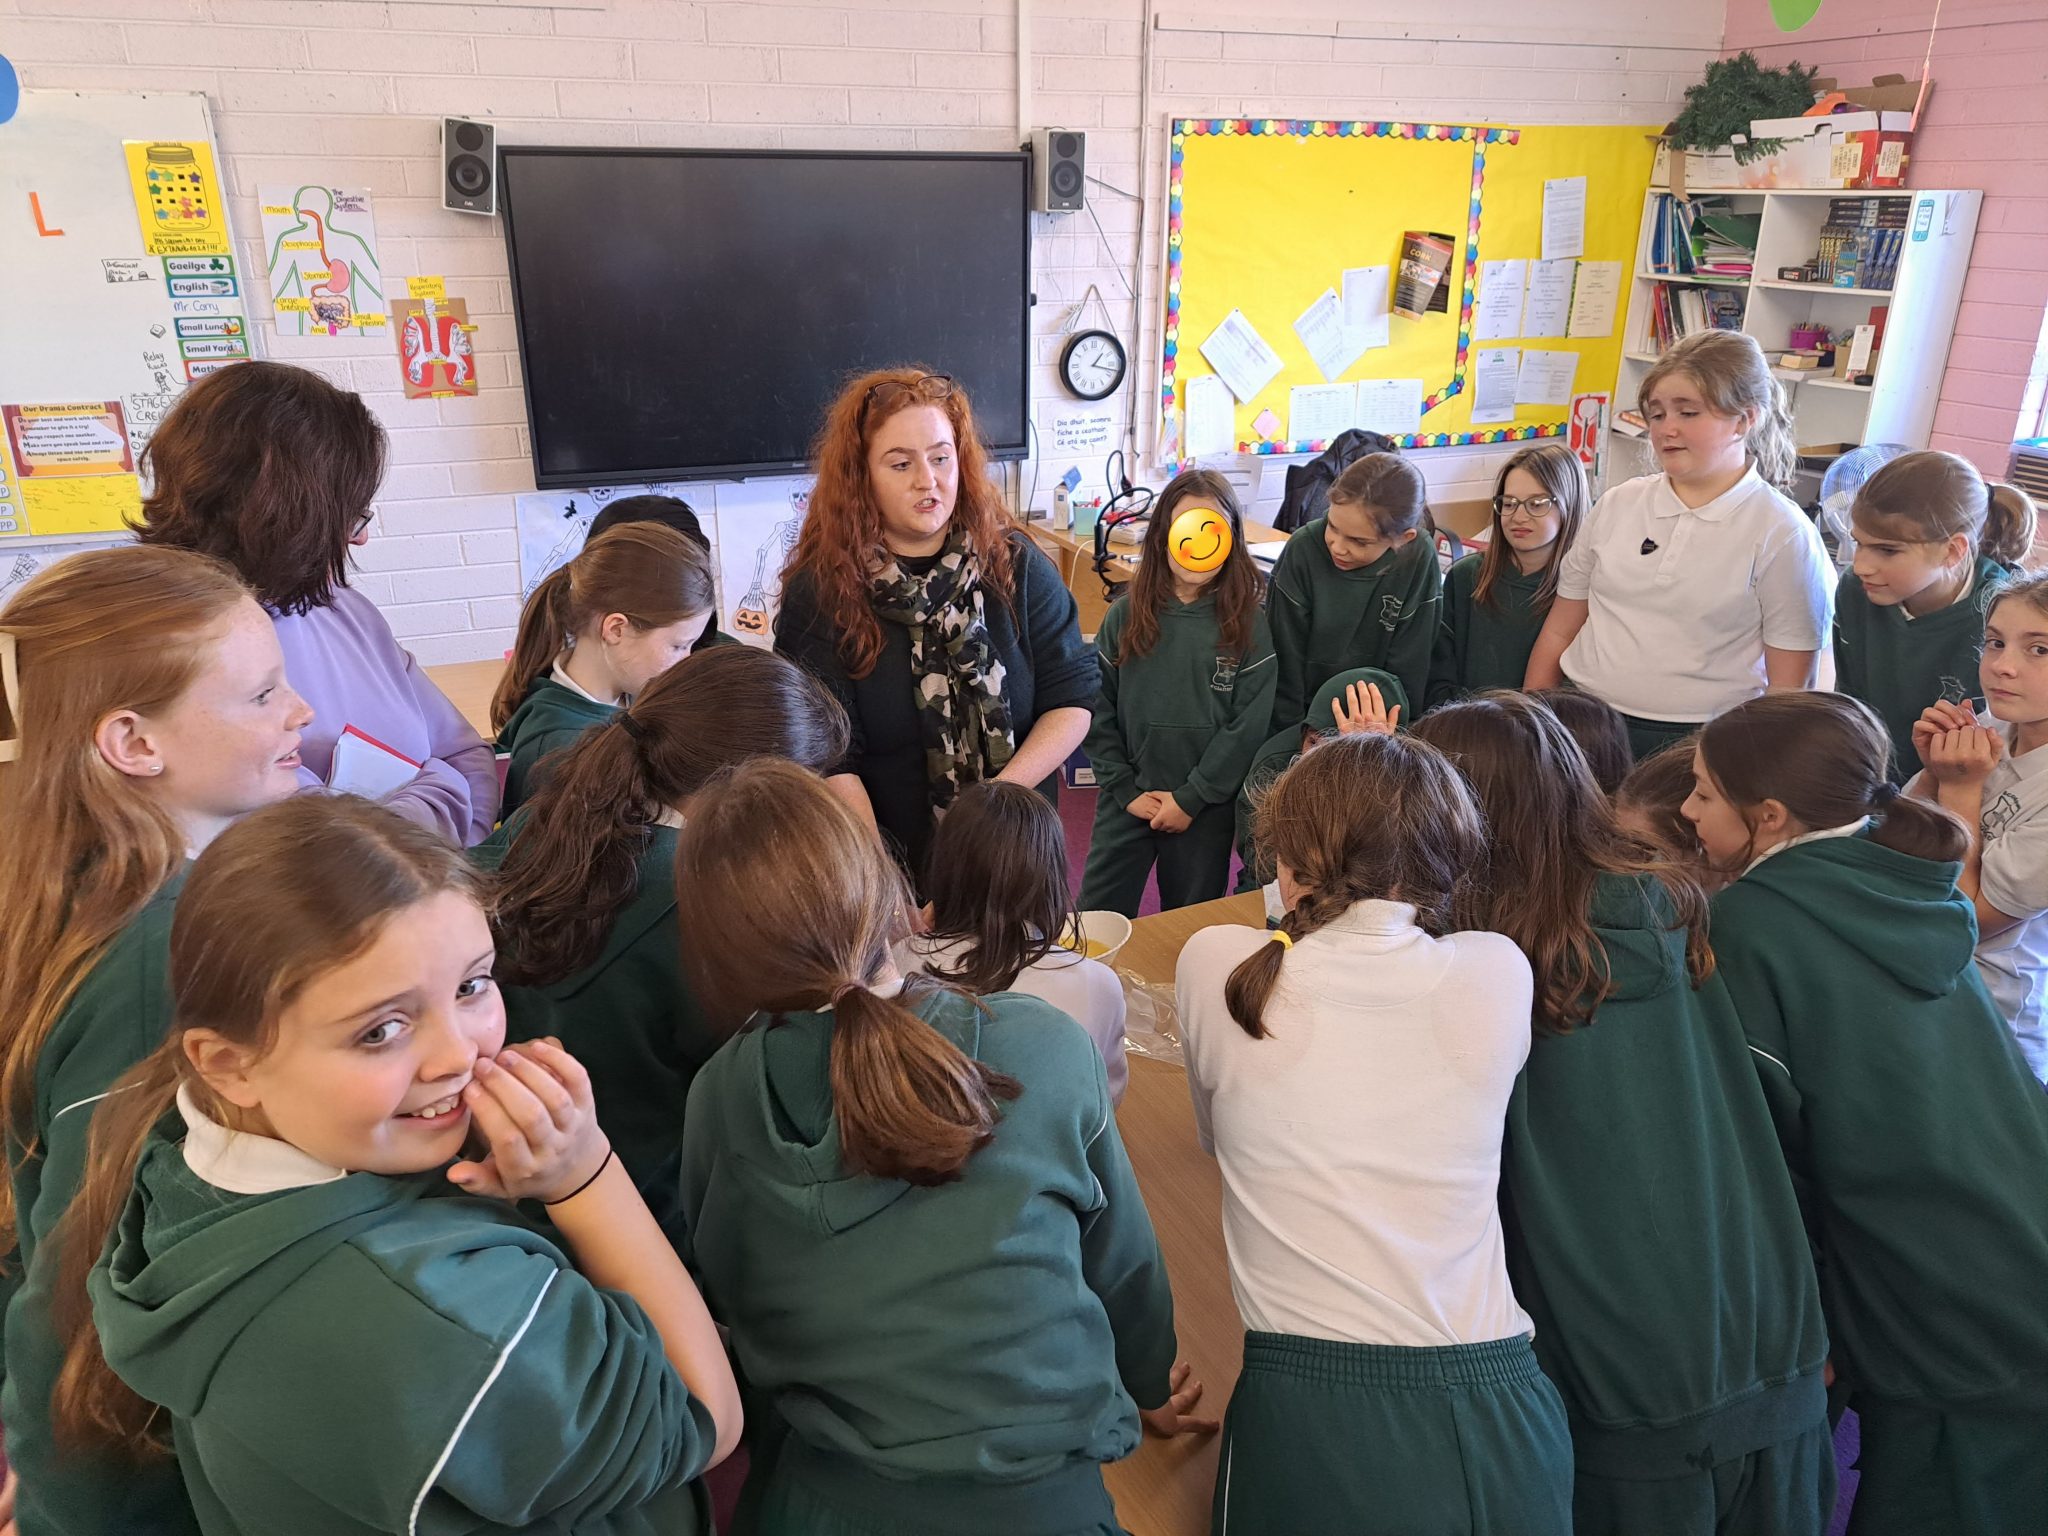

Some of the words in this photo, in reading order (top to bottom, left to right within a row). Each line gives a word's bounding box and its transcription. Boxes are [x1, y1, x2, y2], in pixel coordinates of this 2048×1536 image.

[28, 191, 65, 237] L
[1409, 248, 1432, 261] CORK
[169, 261, 207, 271] Gaeilge
[173, 283, 209, 293] English
[180, 323, 203, 331] Small
[204, 322, 230, 331] Lunch
[186, 345, 211, 353] Small
[213, 344, 234, 352] Yard
[143, 351, 165, 362] Relay
[23, 405, 37, 413] Our
[39, 404, 66, 413] Drama
[66, 403, 103, 412] Contract
[132, 397, 168, 410] STAGE
[1056, 419, 1068, 427] Dia
